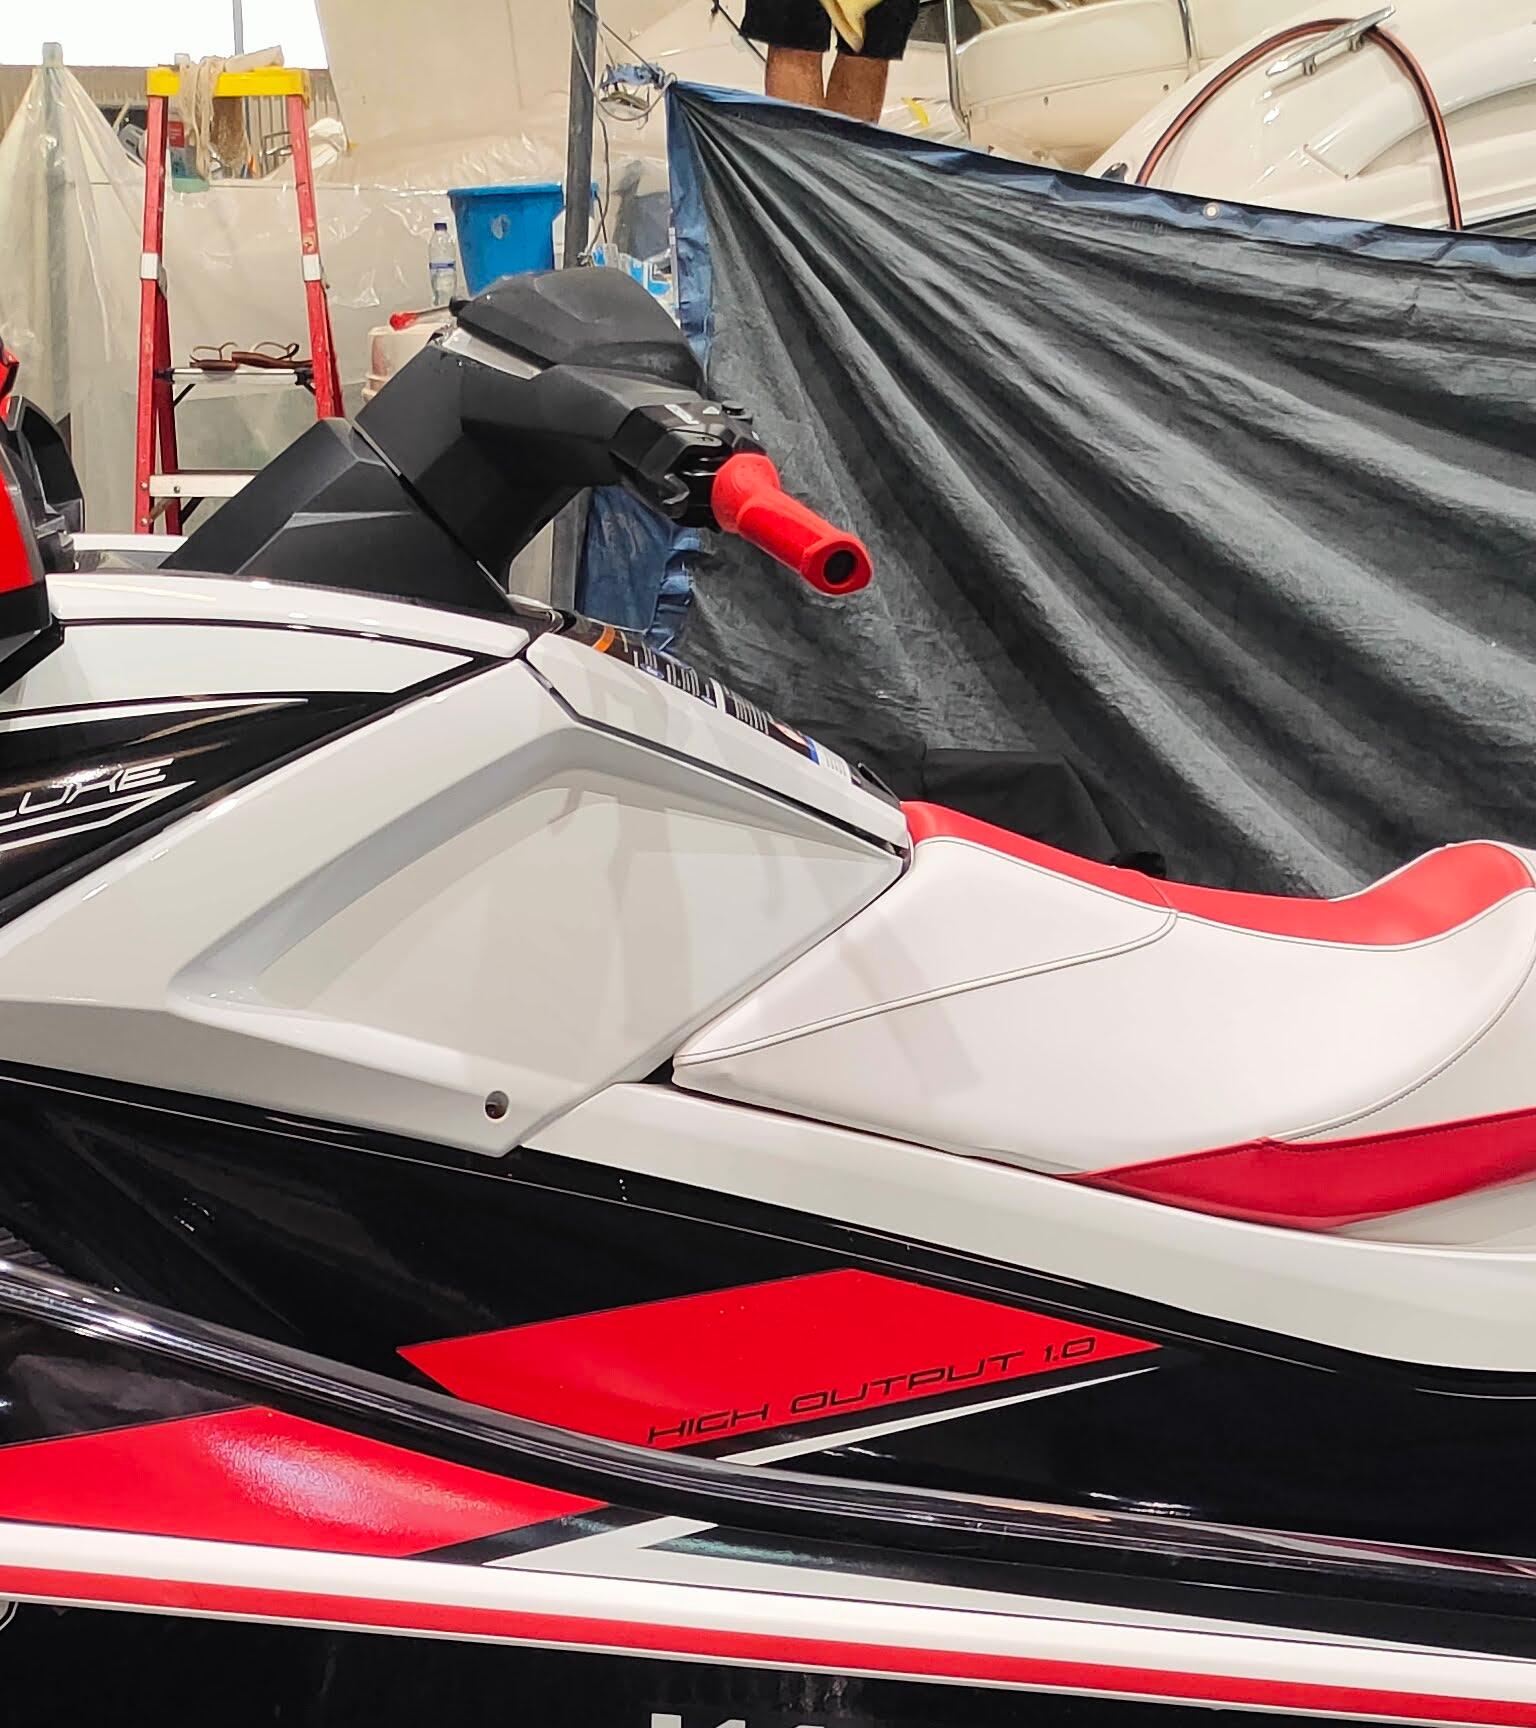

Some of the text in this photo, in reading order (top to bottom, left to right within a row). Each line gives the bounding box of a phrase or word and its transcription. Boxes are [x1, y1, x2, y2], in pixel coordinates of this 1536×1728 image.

[647, 1336, 1097, 1446] HIGH OUTPUT 1.0
